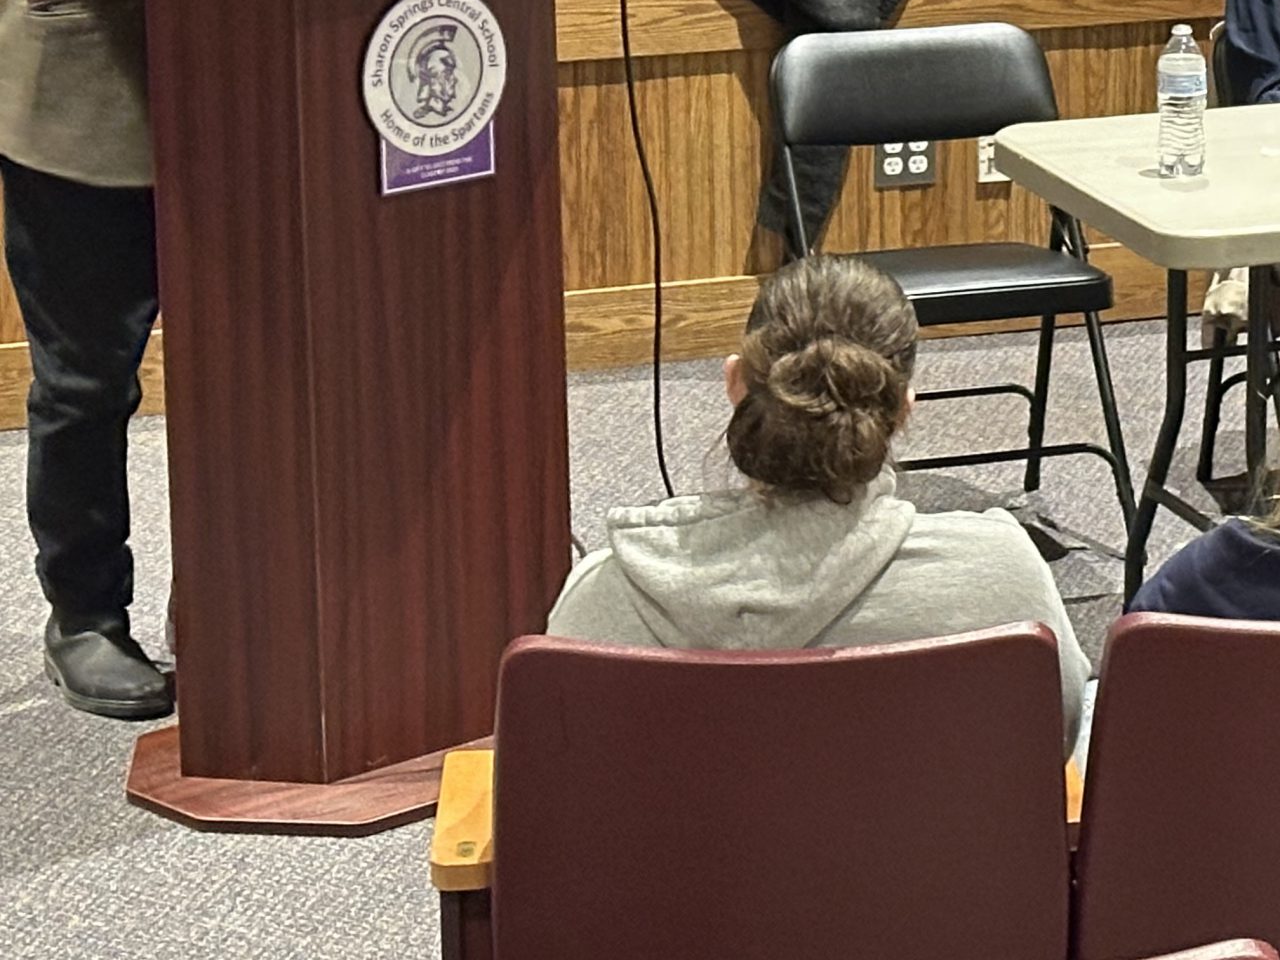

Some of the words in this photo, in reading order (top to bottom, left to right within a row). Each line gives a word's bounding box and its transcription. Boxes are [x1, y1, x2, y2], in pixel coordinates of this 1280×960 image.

[372, 33, 393, 88] Sharon
[477, 17, 499, 68] School
[379, 108, 411, 144] Home
[412, 134, 426, 148] of
[429, 133, 450, 149] the
[451, 91, 495, 143] Spartans
